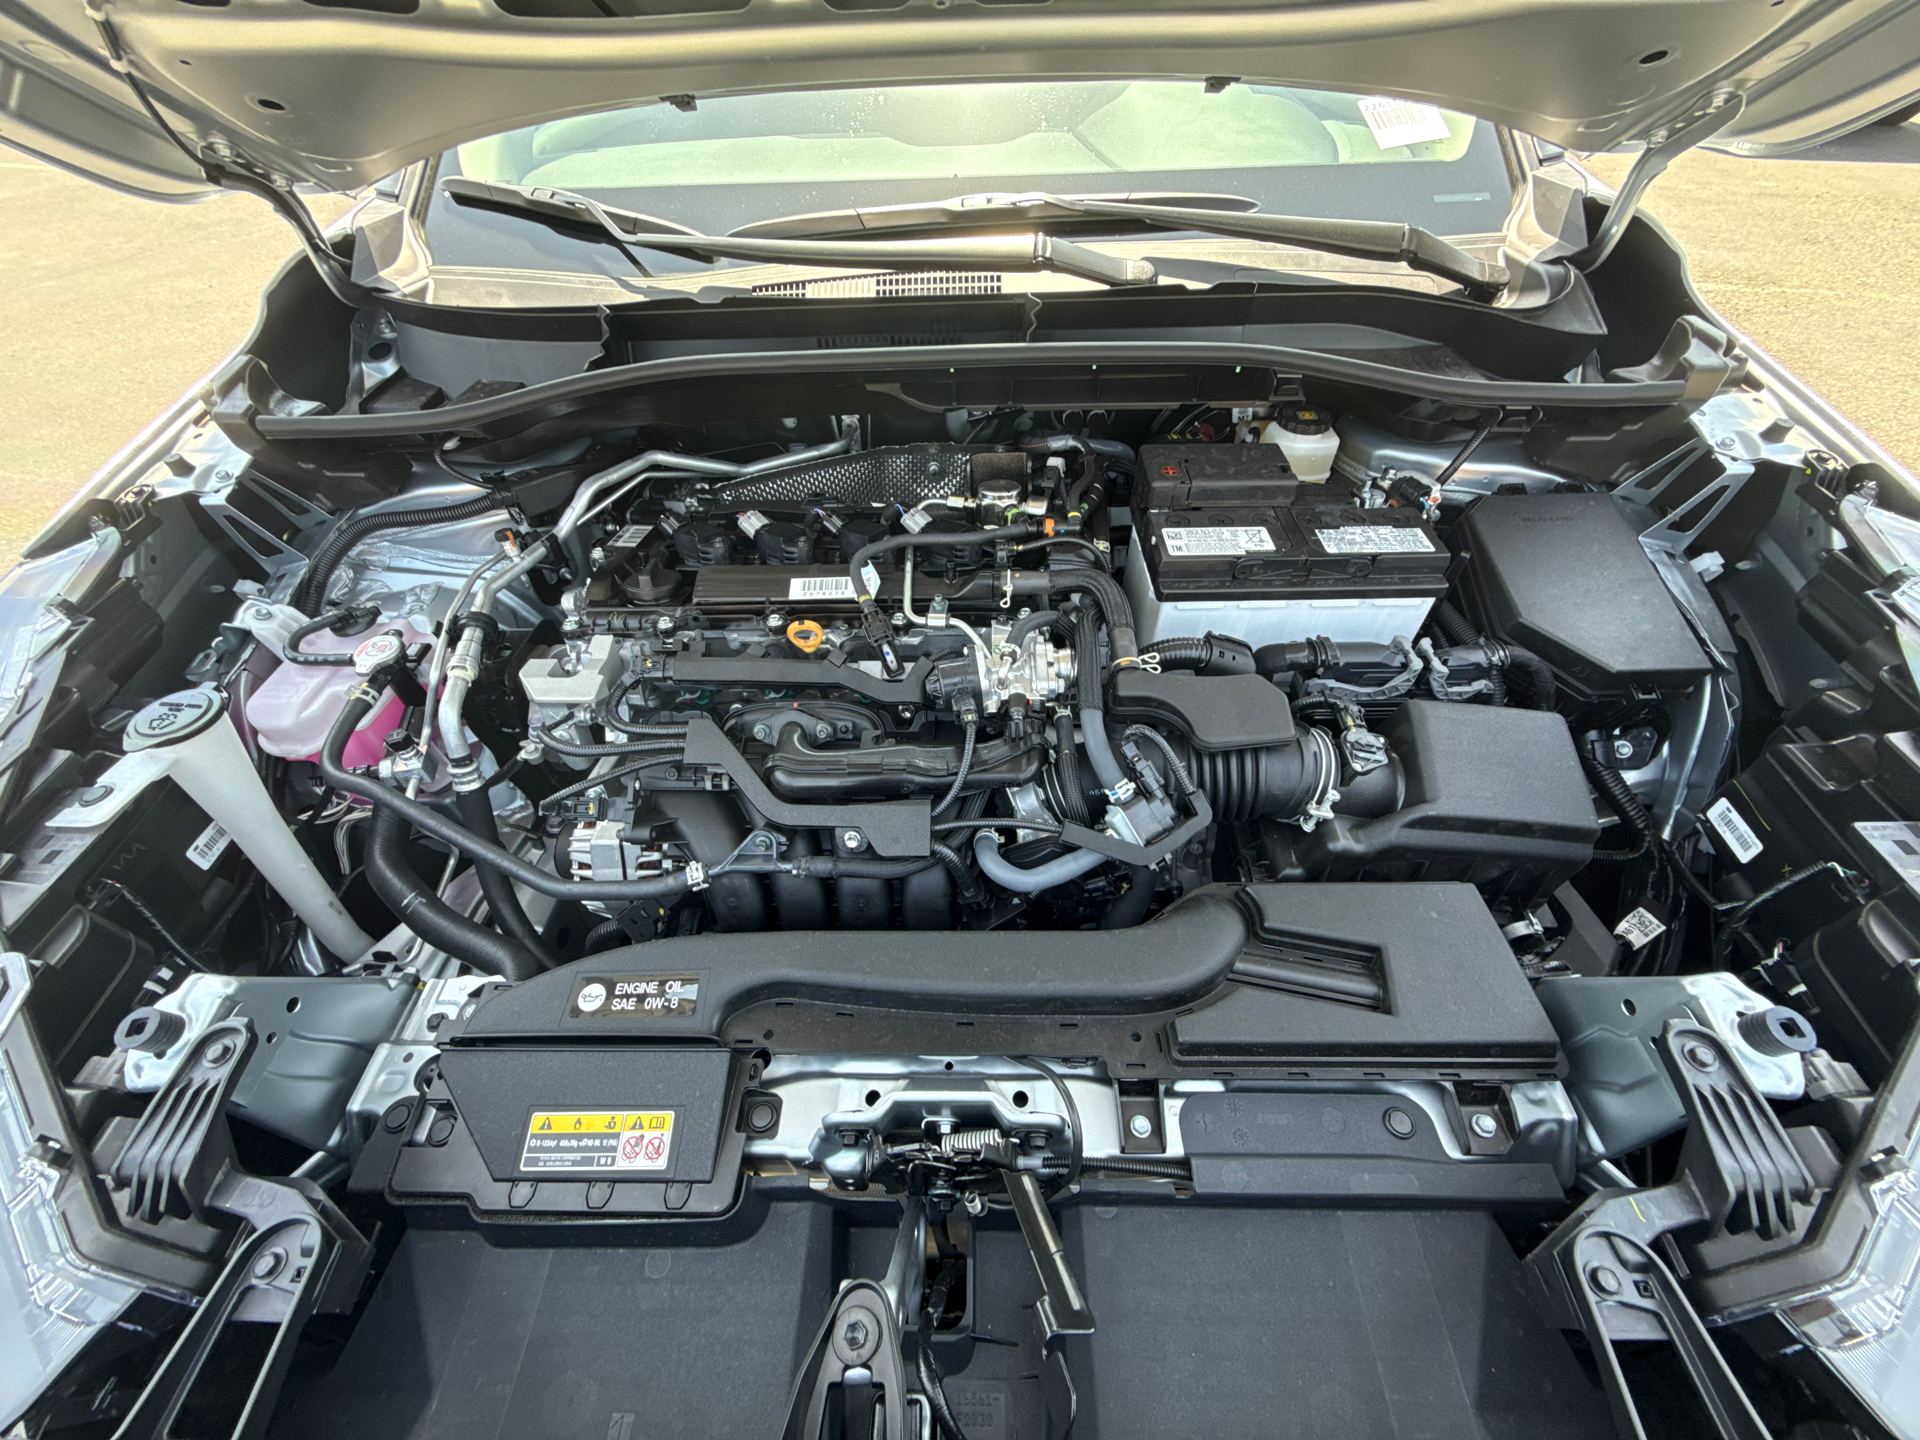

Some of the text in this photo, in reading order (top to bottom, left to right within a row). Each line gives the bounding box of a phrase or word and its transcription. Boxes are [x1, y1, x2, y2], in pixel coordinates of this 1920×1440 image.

[614, 980, 684, 995] ENGINE OIL
[611, 996, 679, 1011] SAE 0W-8
